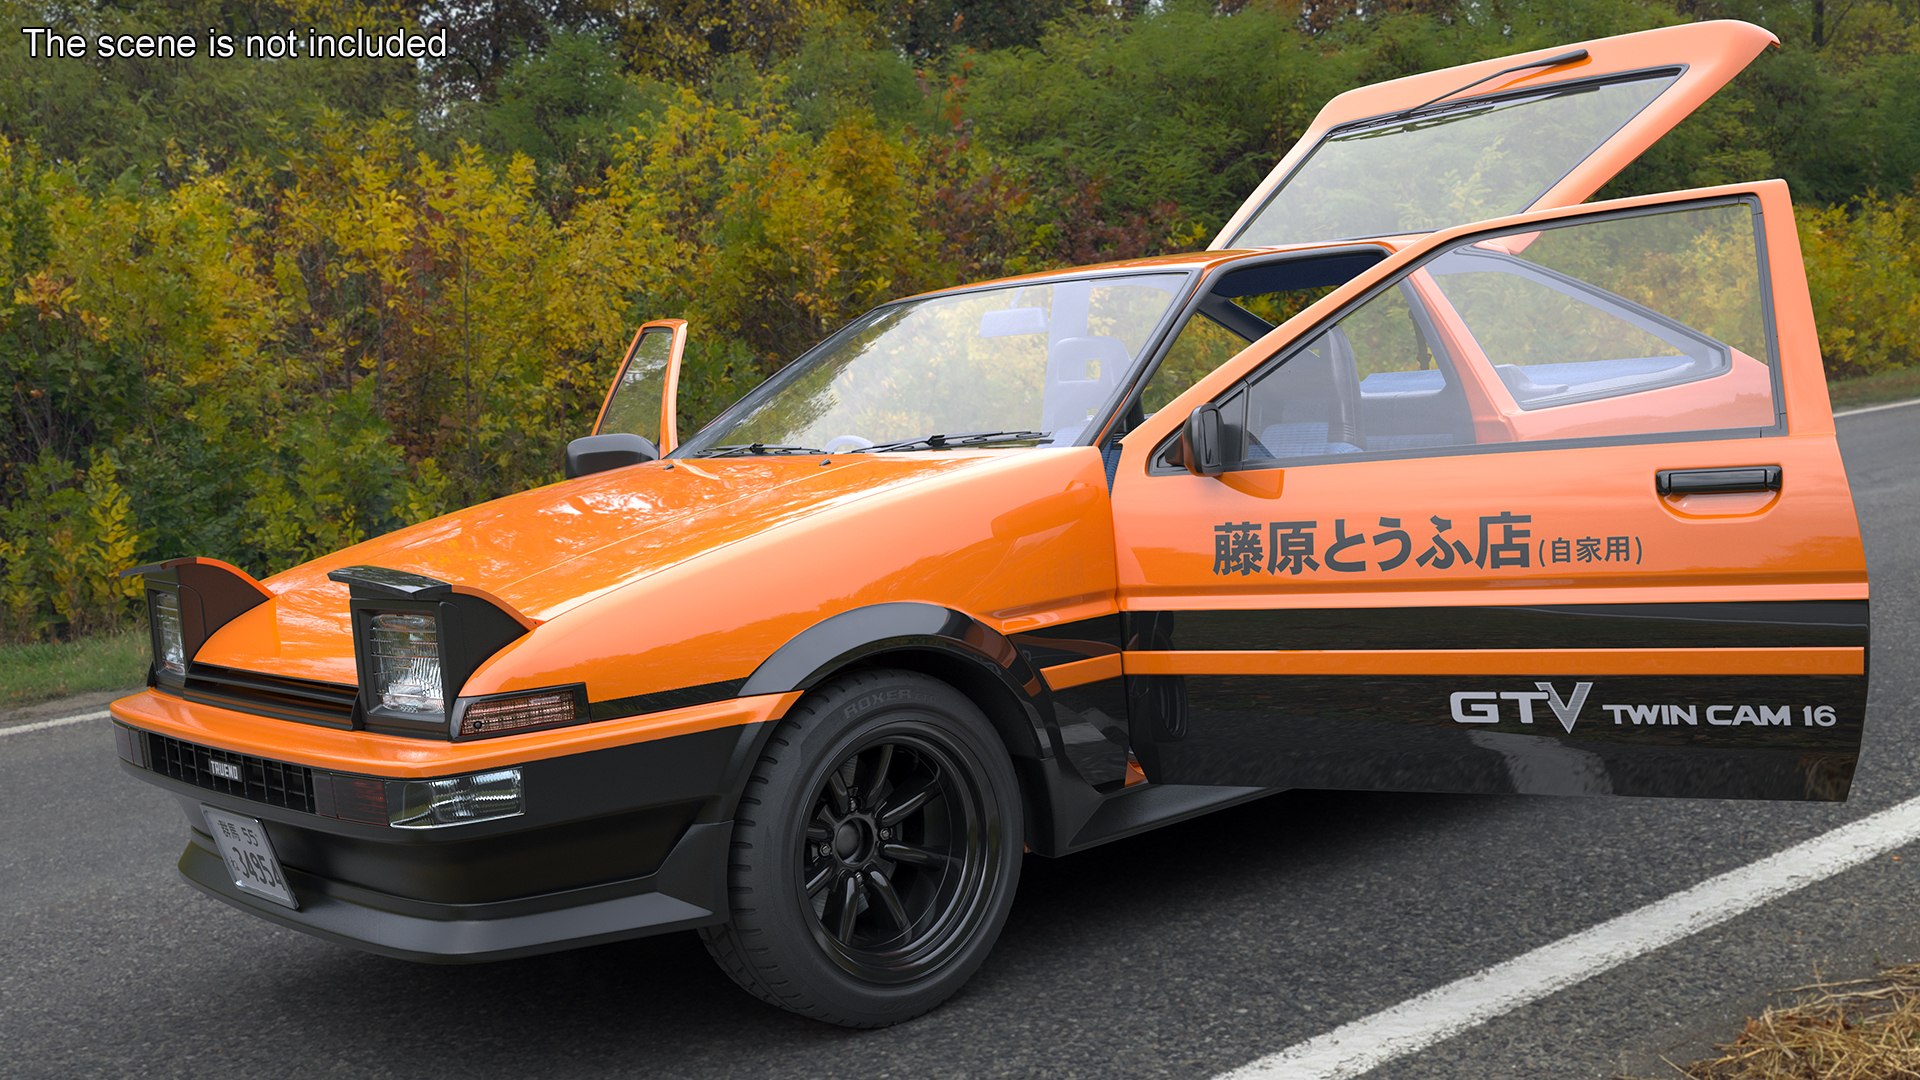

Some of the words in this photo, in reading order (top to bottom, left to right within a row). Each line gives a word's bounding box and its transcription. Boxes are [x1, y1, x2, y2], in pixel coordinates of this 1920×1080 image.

[1212, 511, 1532, 576] 藤原とうふ店
[1449, 682, 1593, 734] GTV
[1602, 704, 1698, 725] TWIN
[1705, 704, 1792, 726] CAM
[1803, 705, 1837, 727] 16
[210, 760, 239, 780] TRUENO
[240, 826, 259, 847] 55
